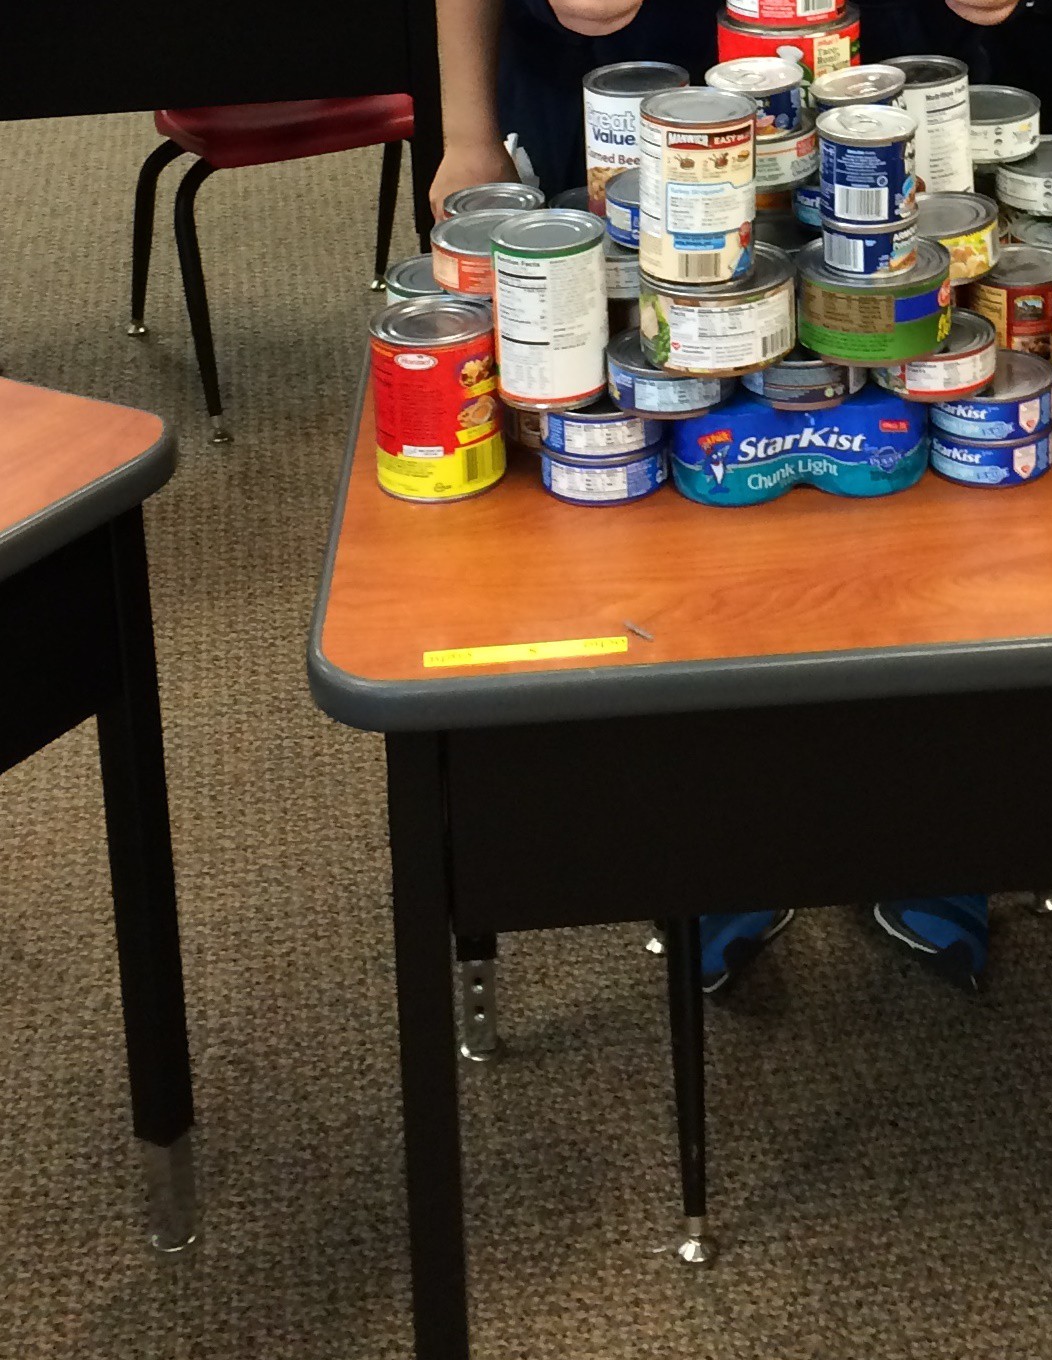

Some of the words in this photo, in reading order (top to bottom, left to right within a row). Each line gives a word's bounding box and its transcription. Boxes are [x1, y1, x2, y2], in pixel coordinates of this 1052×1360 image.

[592, 127, 637, 146] Value
[618, 154, 641, 165] Bee
[737, 426, 867, 462] StarKist
[747, 464, 795, 490] Chunk
[798, 459, 839, 477] Light
